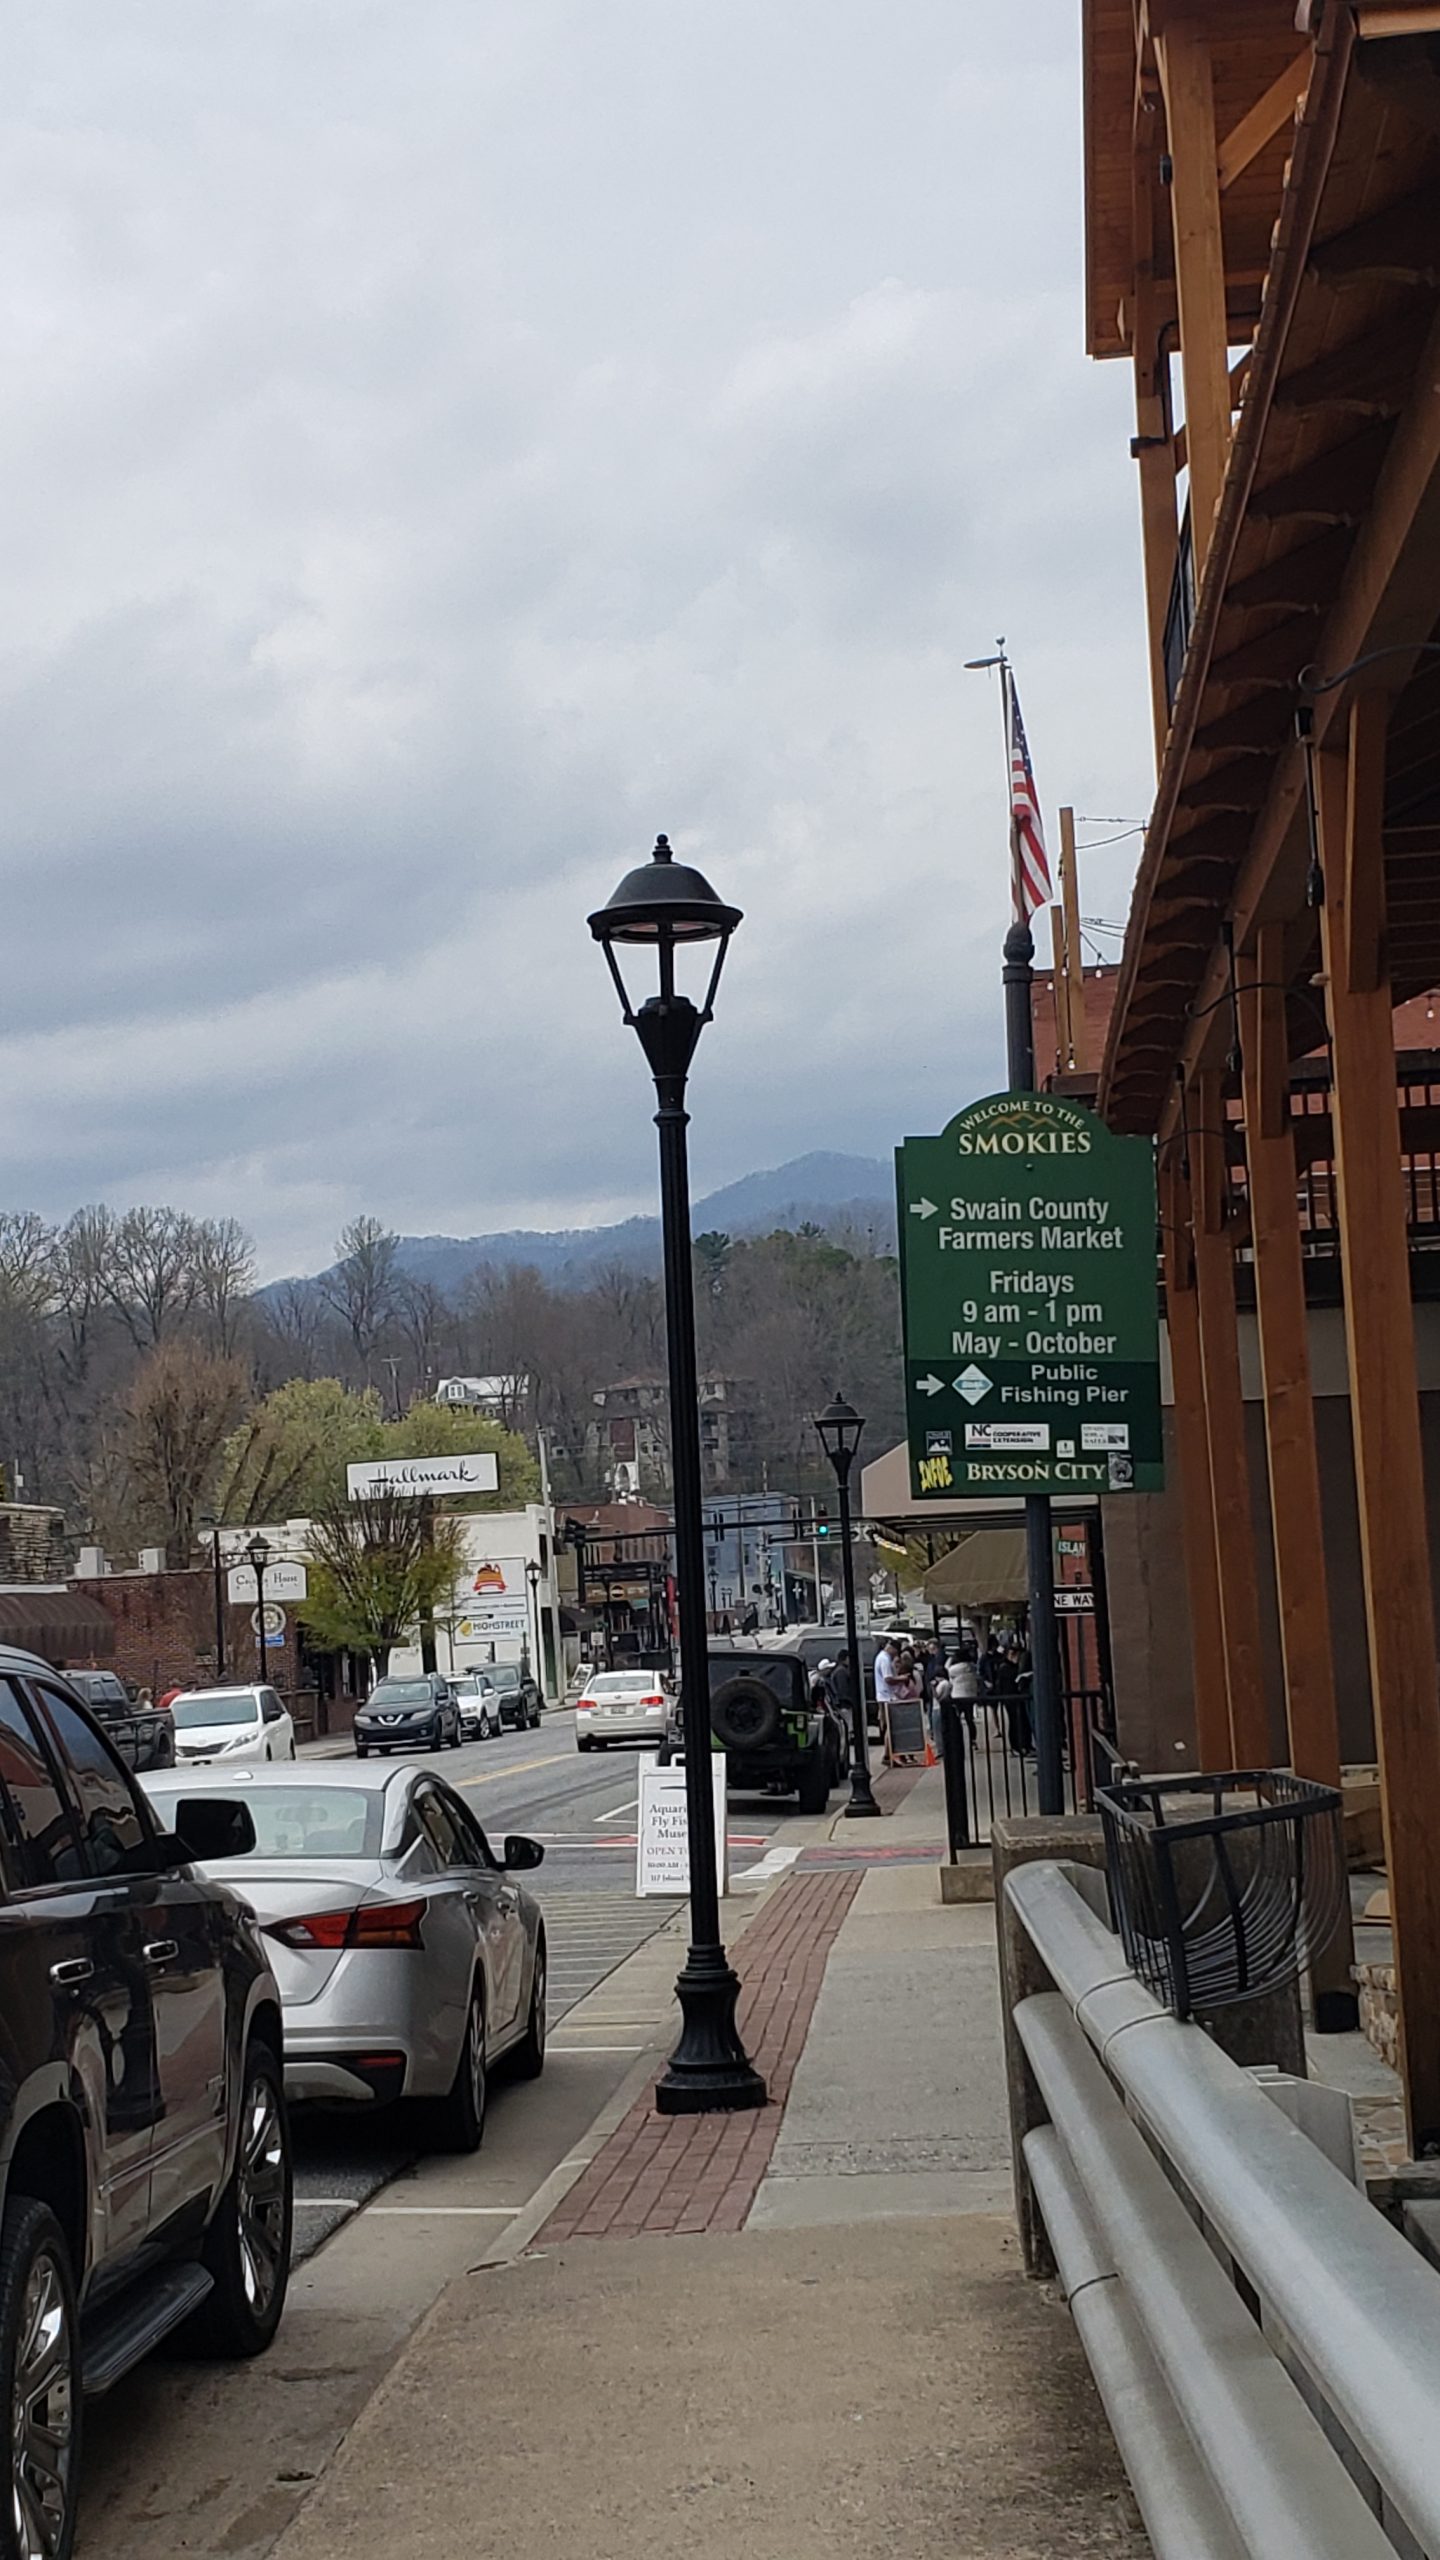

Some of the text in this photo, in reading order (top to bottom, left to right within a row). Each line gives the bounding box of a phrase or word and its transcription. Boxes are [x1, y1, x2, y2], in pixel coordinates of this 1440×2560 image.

[959, 1100, 1086, 1132] WELCOME TO THE
[958, 1131, 1092, 1156] SMOKIES
[950, 1197, 1109, 1225] Swain County
[938, 1226, 1124, 1250] Farmers Market
[989, 1270, 1075, 1297] Fridays
[962, 1300, 978, 1323] 9
[984, 1305, 1021, 1323] am
[1044, 1300, 1057, 1323] 1
[1066, 1304, 1103, 1327] pm
[951, 1331, 1001, 1359] May
[1025, 1331, 1117, 1355] October
[1030, 1364, 1099, 1381] Public
[1000, 1385, 1129, 1407] Fishing Pier
[971, 1424, 993, 1437] NC
[366, 1460, 480, 1485] Hallmark
[966, 1462, 1050, 1481] BRYSON
[1054, 1461, 1106, 1480] CITY
[1058, 1541, 1086, 1556] ISLAN
[1054, 1594, 1069, 1606] NE
[648, 1804, 687, 1815] Aquari
[651, 1816, 688, 1828] Fly Fis
[656, 1829, 687, 1839] Muse
[646, 1847, 676, 1856] OPEN
